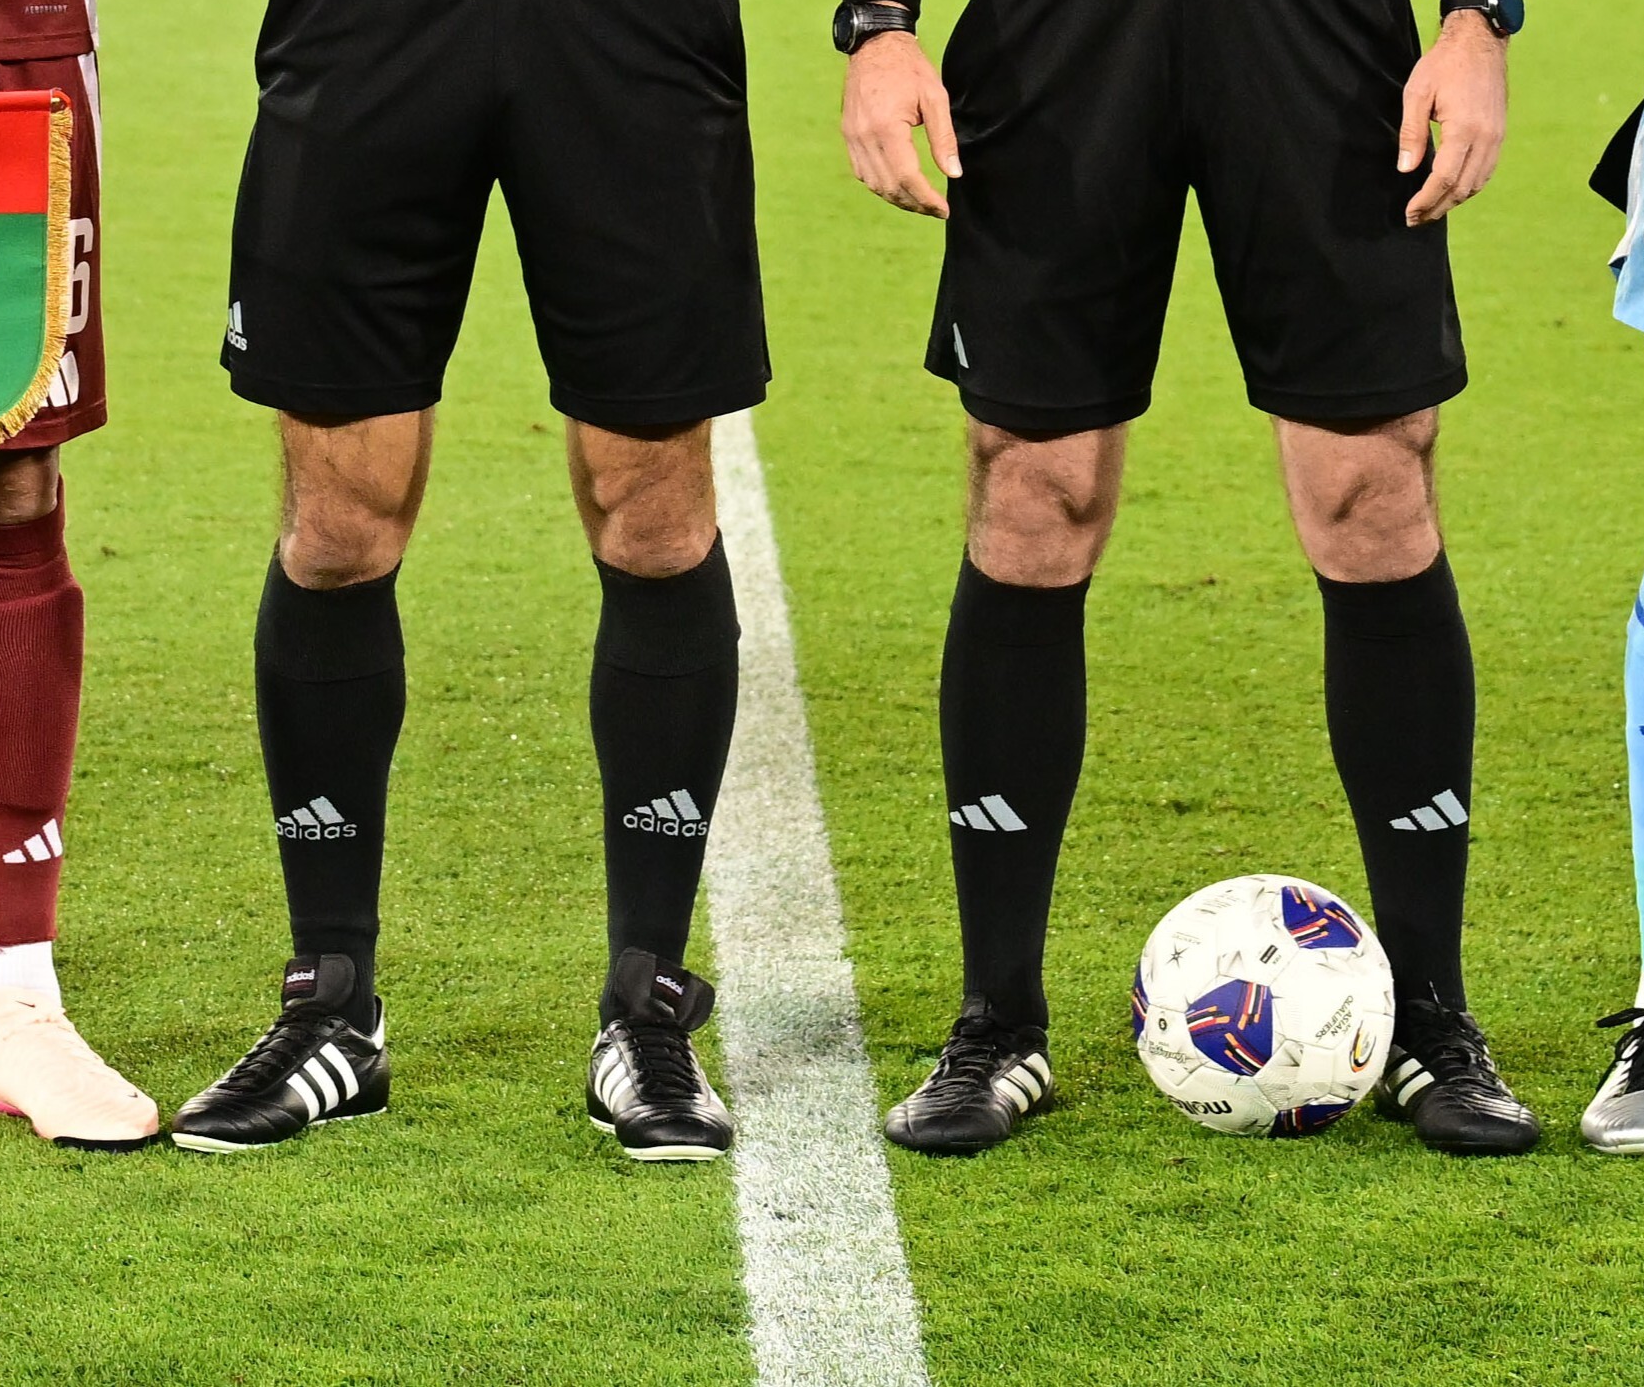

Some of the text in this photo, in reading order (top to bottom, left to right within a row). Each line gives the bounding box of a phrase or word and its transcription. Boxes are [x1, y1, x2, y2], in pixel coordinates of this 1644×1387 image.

[275, 819, 358, 840] adidas
[623, 813, 708, 837] adidas
[1329, 1011, 1353, 1037] ASIAN
